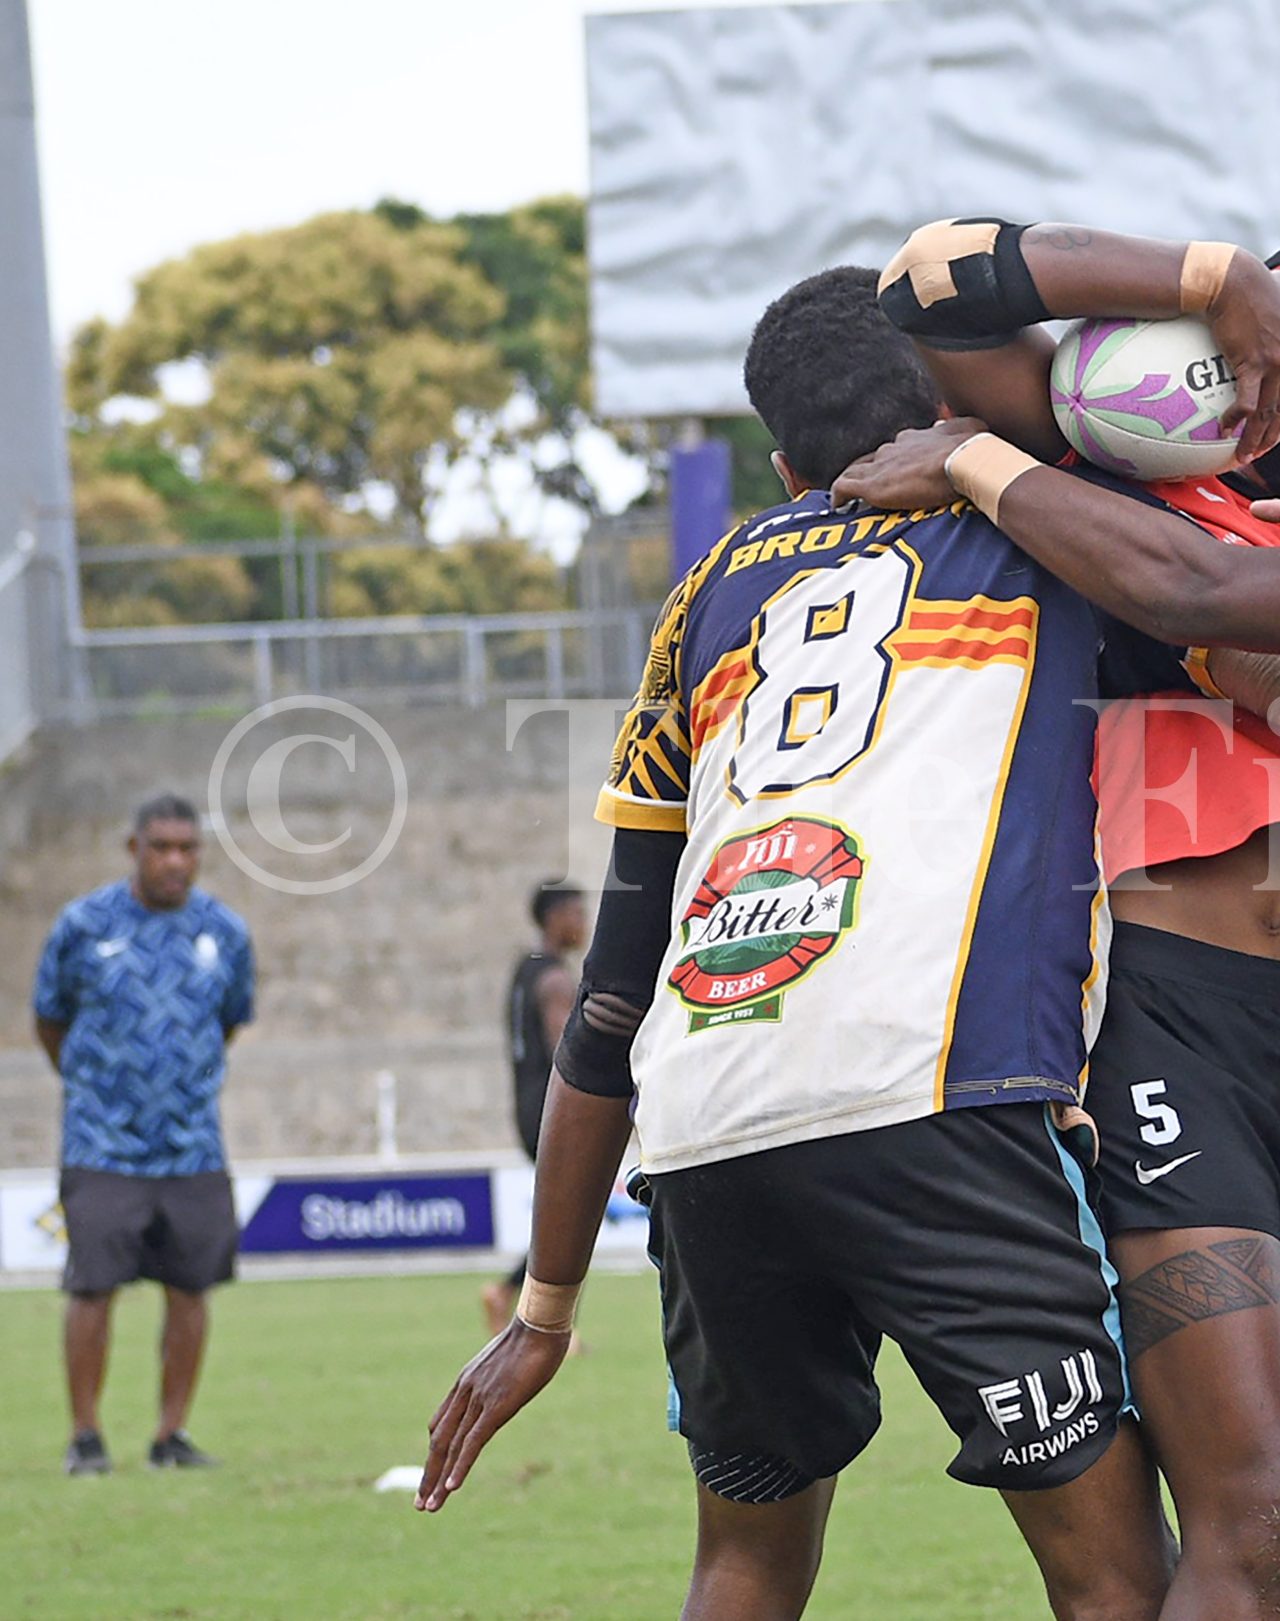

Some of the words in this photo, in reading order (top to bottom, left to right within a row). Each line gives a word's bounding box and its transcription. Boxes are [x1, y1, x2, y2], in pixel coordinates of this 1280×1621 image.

[725, 537, 924, 808] 8
[691, 895, 820, 946] Bitter
[707, 971, 767, 999] BEER
[1130, 1079, 1183, 1147] 5
[300, 1193, 467, 1241] Stadium
[978, 1348, 1104, 1438] FIJI
[1001, 1411, 1100, 1466] AIRWAYS
